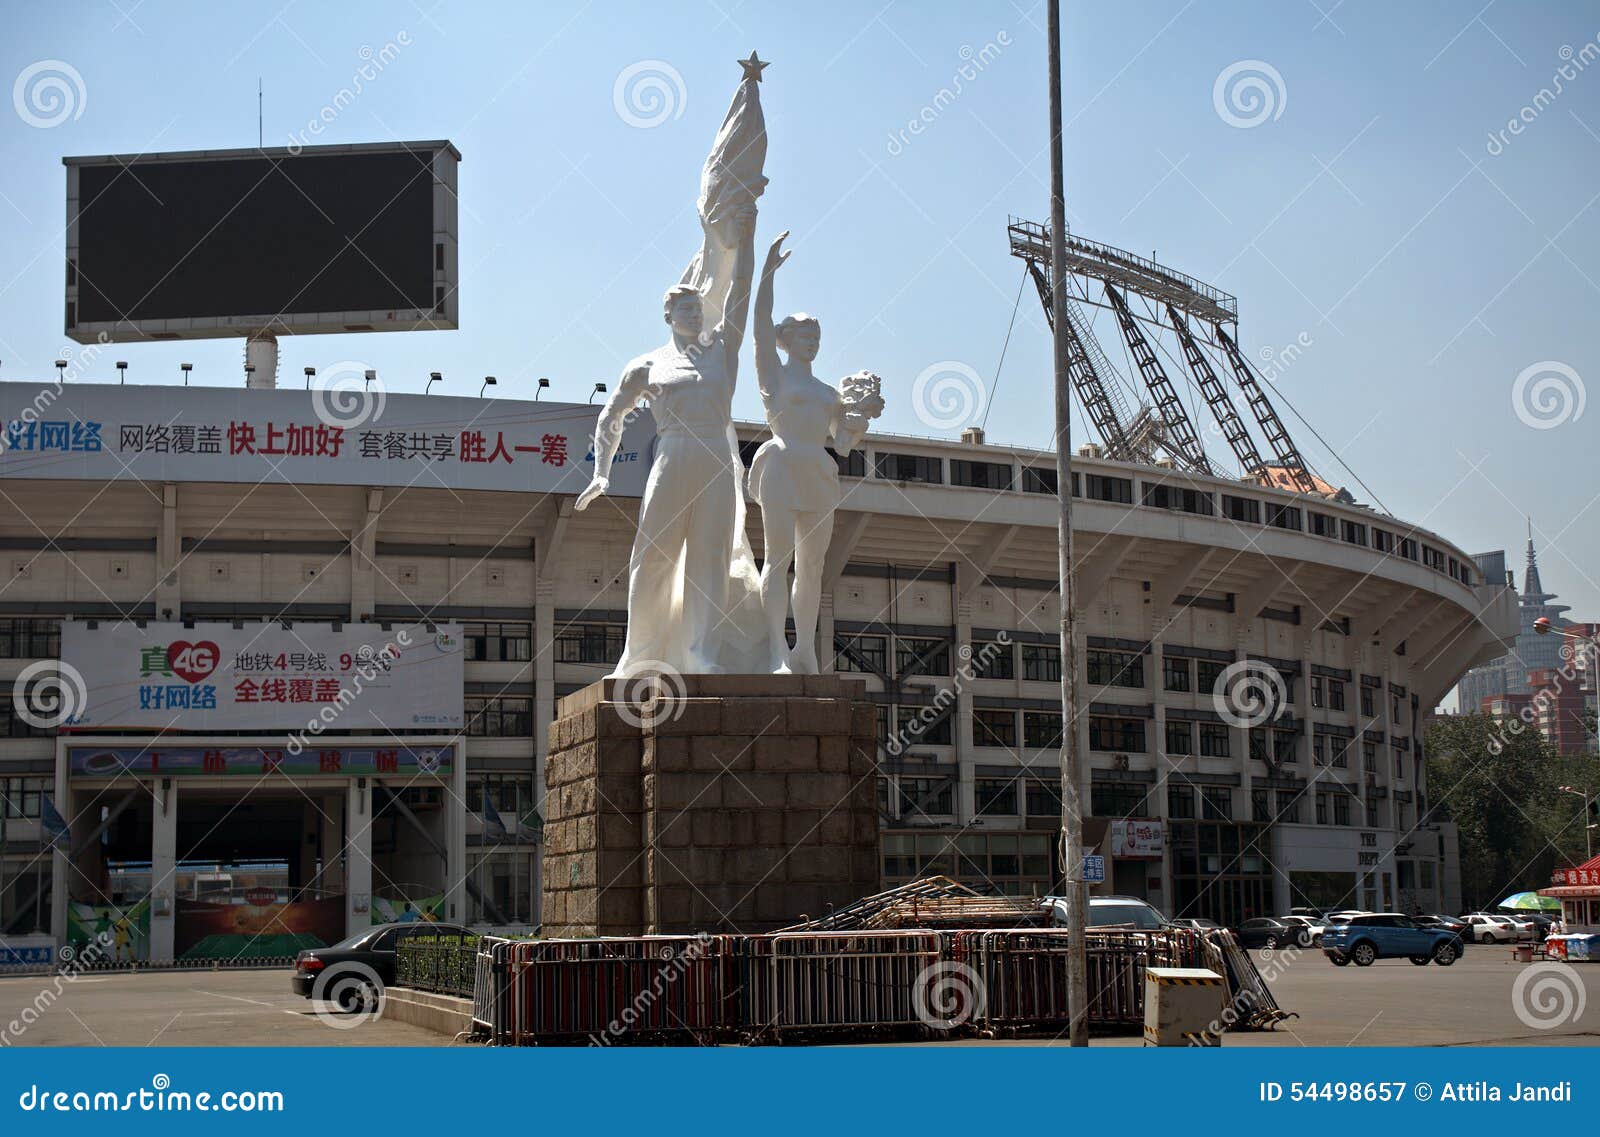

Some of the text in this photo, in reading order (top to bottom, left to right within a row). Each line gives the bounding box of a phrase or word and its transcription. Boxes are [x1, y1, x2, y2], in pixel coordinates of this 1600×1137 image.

[8, 420, 102, 451] 好网络
[139, 685, 216, 710] 好网络
[234, 678, 341, 704] 全线覆盖
